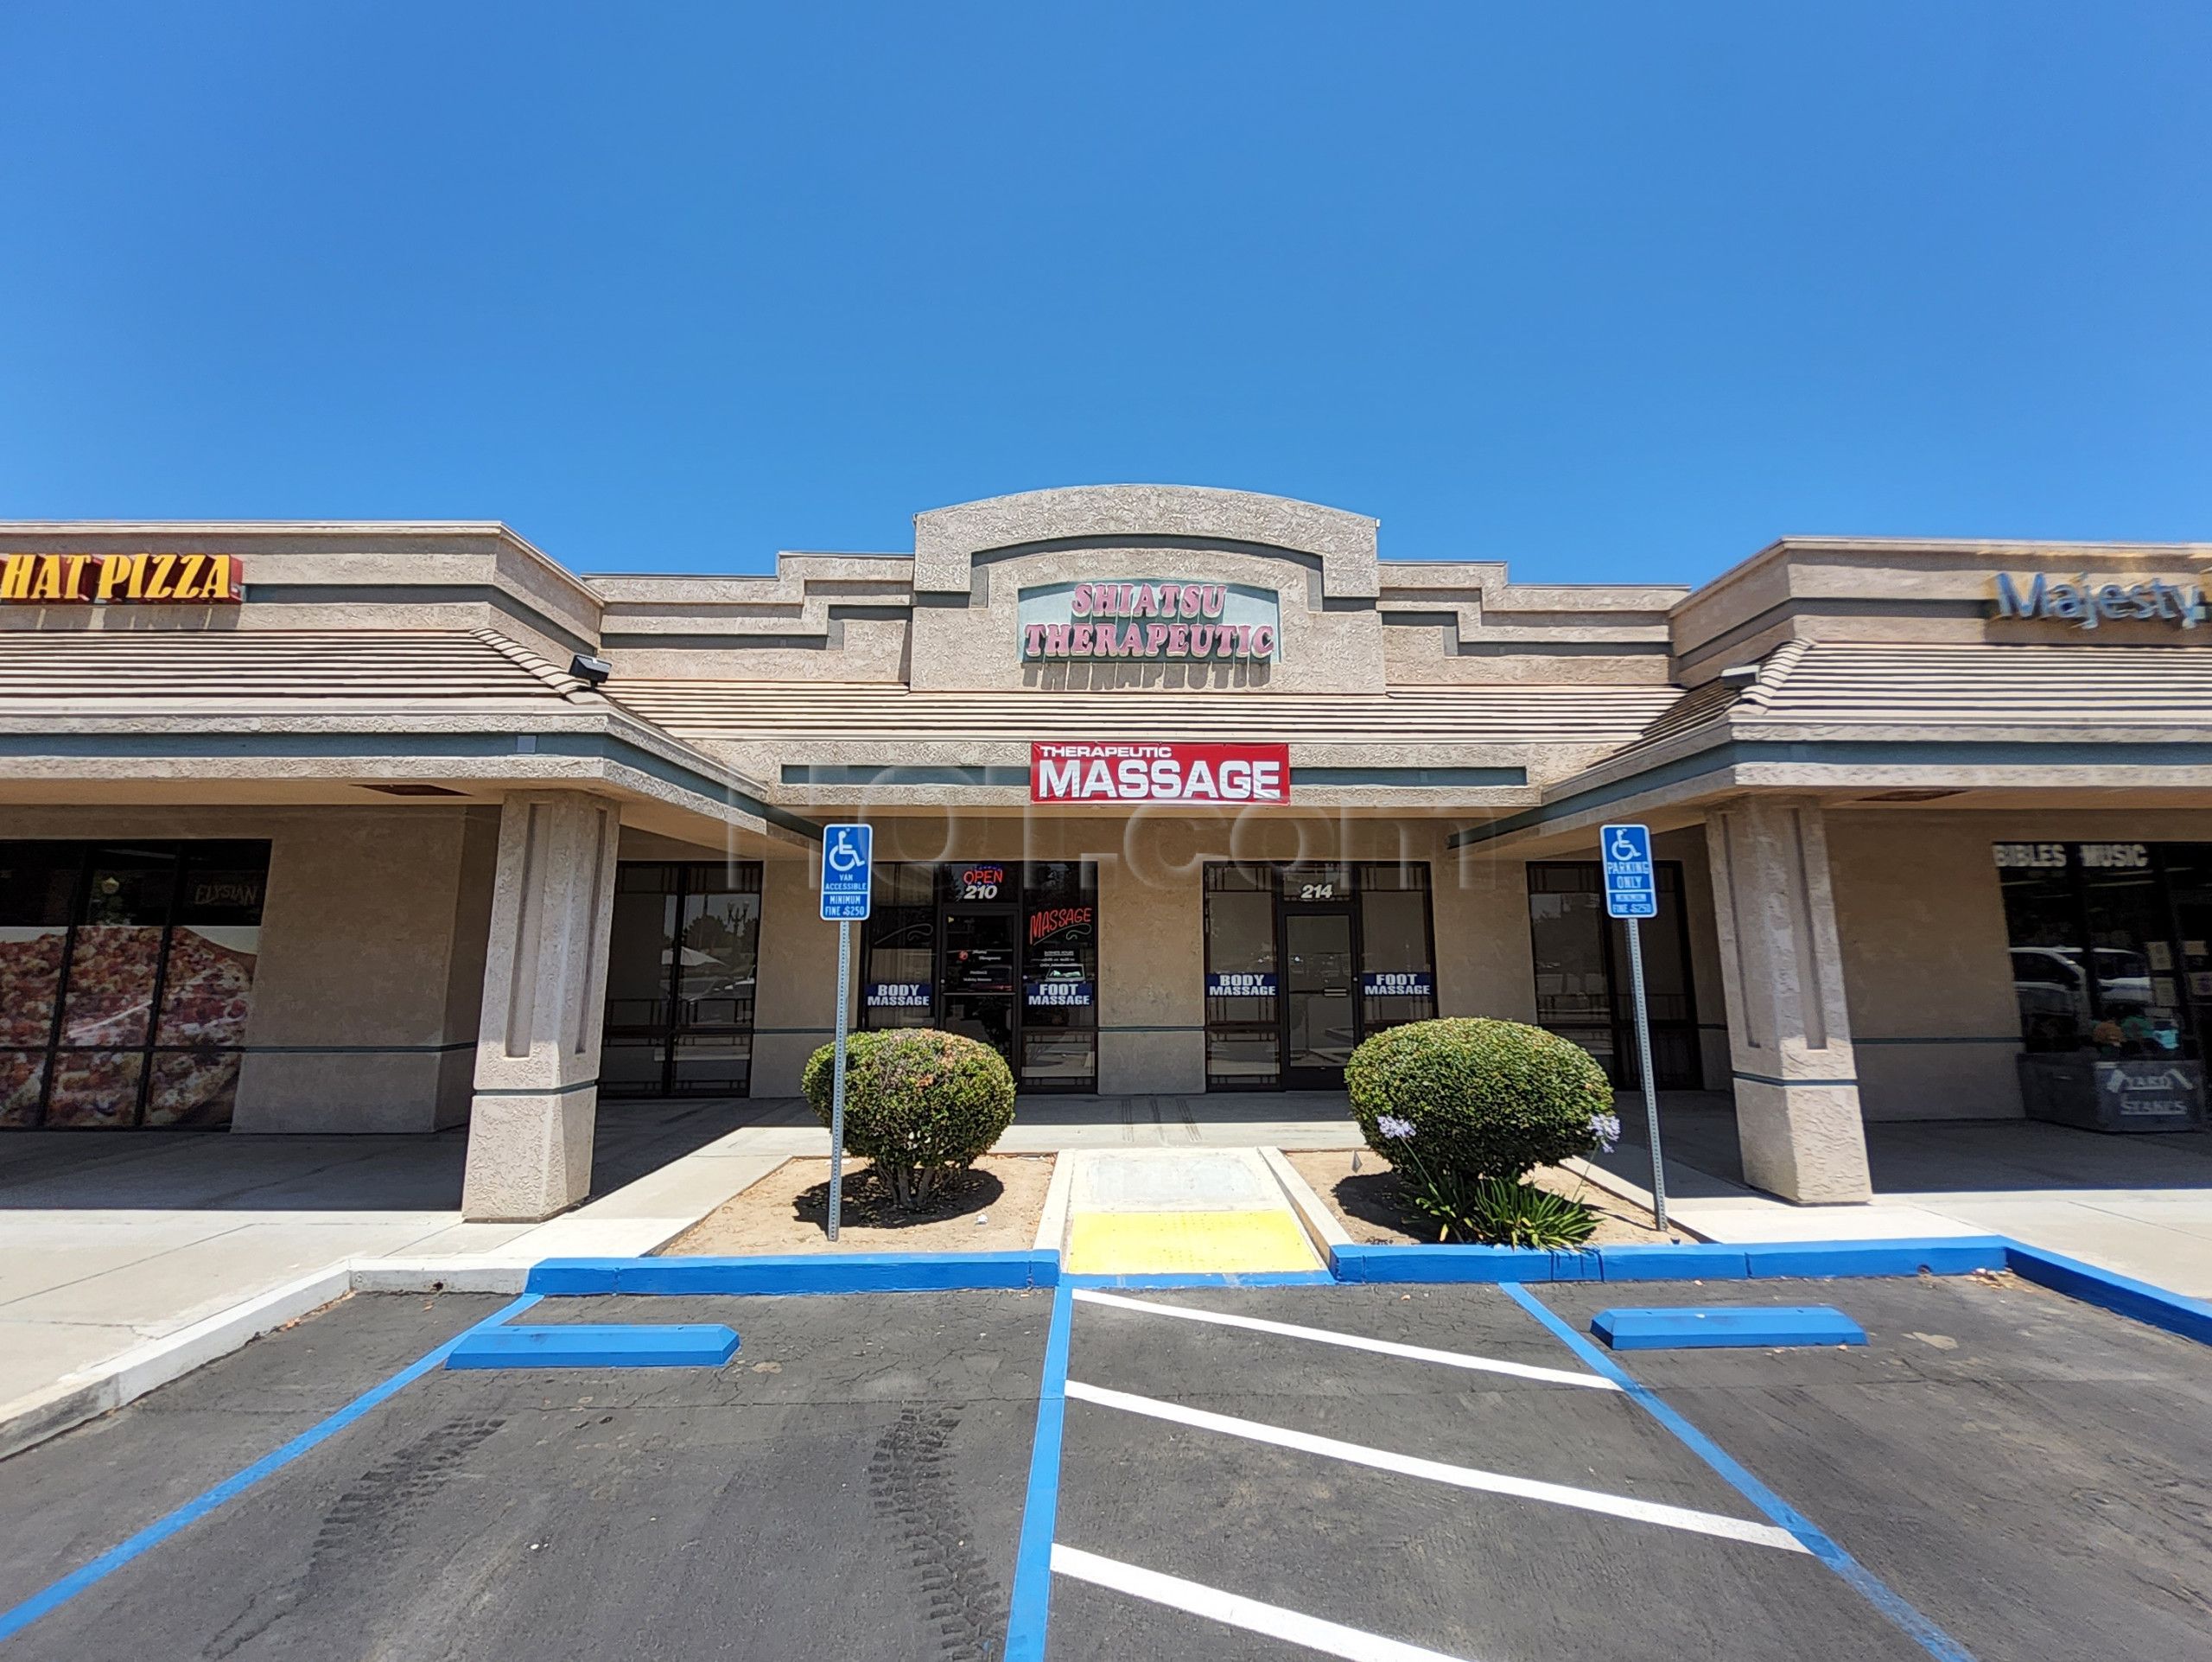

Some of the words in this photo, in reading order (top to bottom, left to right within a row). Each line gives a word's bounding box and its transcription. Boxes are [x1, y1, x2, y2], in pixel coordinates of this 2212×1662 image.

[0, 554, 92, 599] HAT
[97, 553, 231, 599] PIZZA
[1071, 583, 1227, 619] SHIATSU
[1994, 571, 2202, 630] Majesty
[1024, 622, 1274, 659] THERAPEUTIC
[1039, 745, 1172, 758] THERAPEUTIC
[1039, 759, 1281, 799] MASSAGE
[1993, 844, 2067, 867] BIBLES
[2080, 844, 2149, 867] MUSIC
[1607, 861, 1649, 875] PARKING
[963, 869, 1002, 883] OPEN
[1617, 876, 1643, 888] ONLY
[963, 884, 998, 900] 210
[1300, 883, 1333, 899] 214
[830, 895, 861, 904] MINIMUM
[824, 906, 841, 916] FINE
[843, 906, 865, 916] $250
[1029, 907, 1092, 946] MASSAGE
[1219, 974, 1264, 986] BODY
[1376, 973, 1418, 985] FOOT
[877, 984, 919, 997] BODY
[1039, 984, 1078, 996] FOOT
[1209, 985, 1276, 996] MASSAGE
[1364, 985, 1431, 995] MASSAGE
[867, 996, 930, 1006] MASSAGE
[1028, 996, 1090, 1005] MASSAGE
